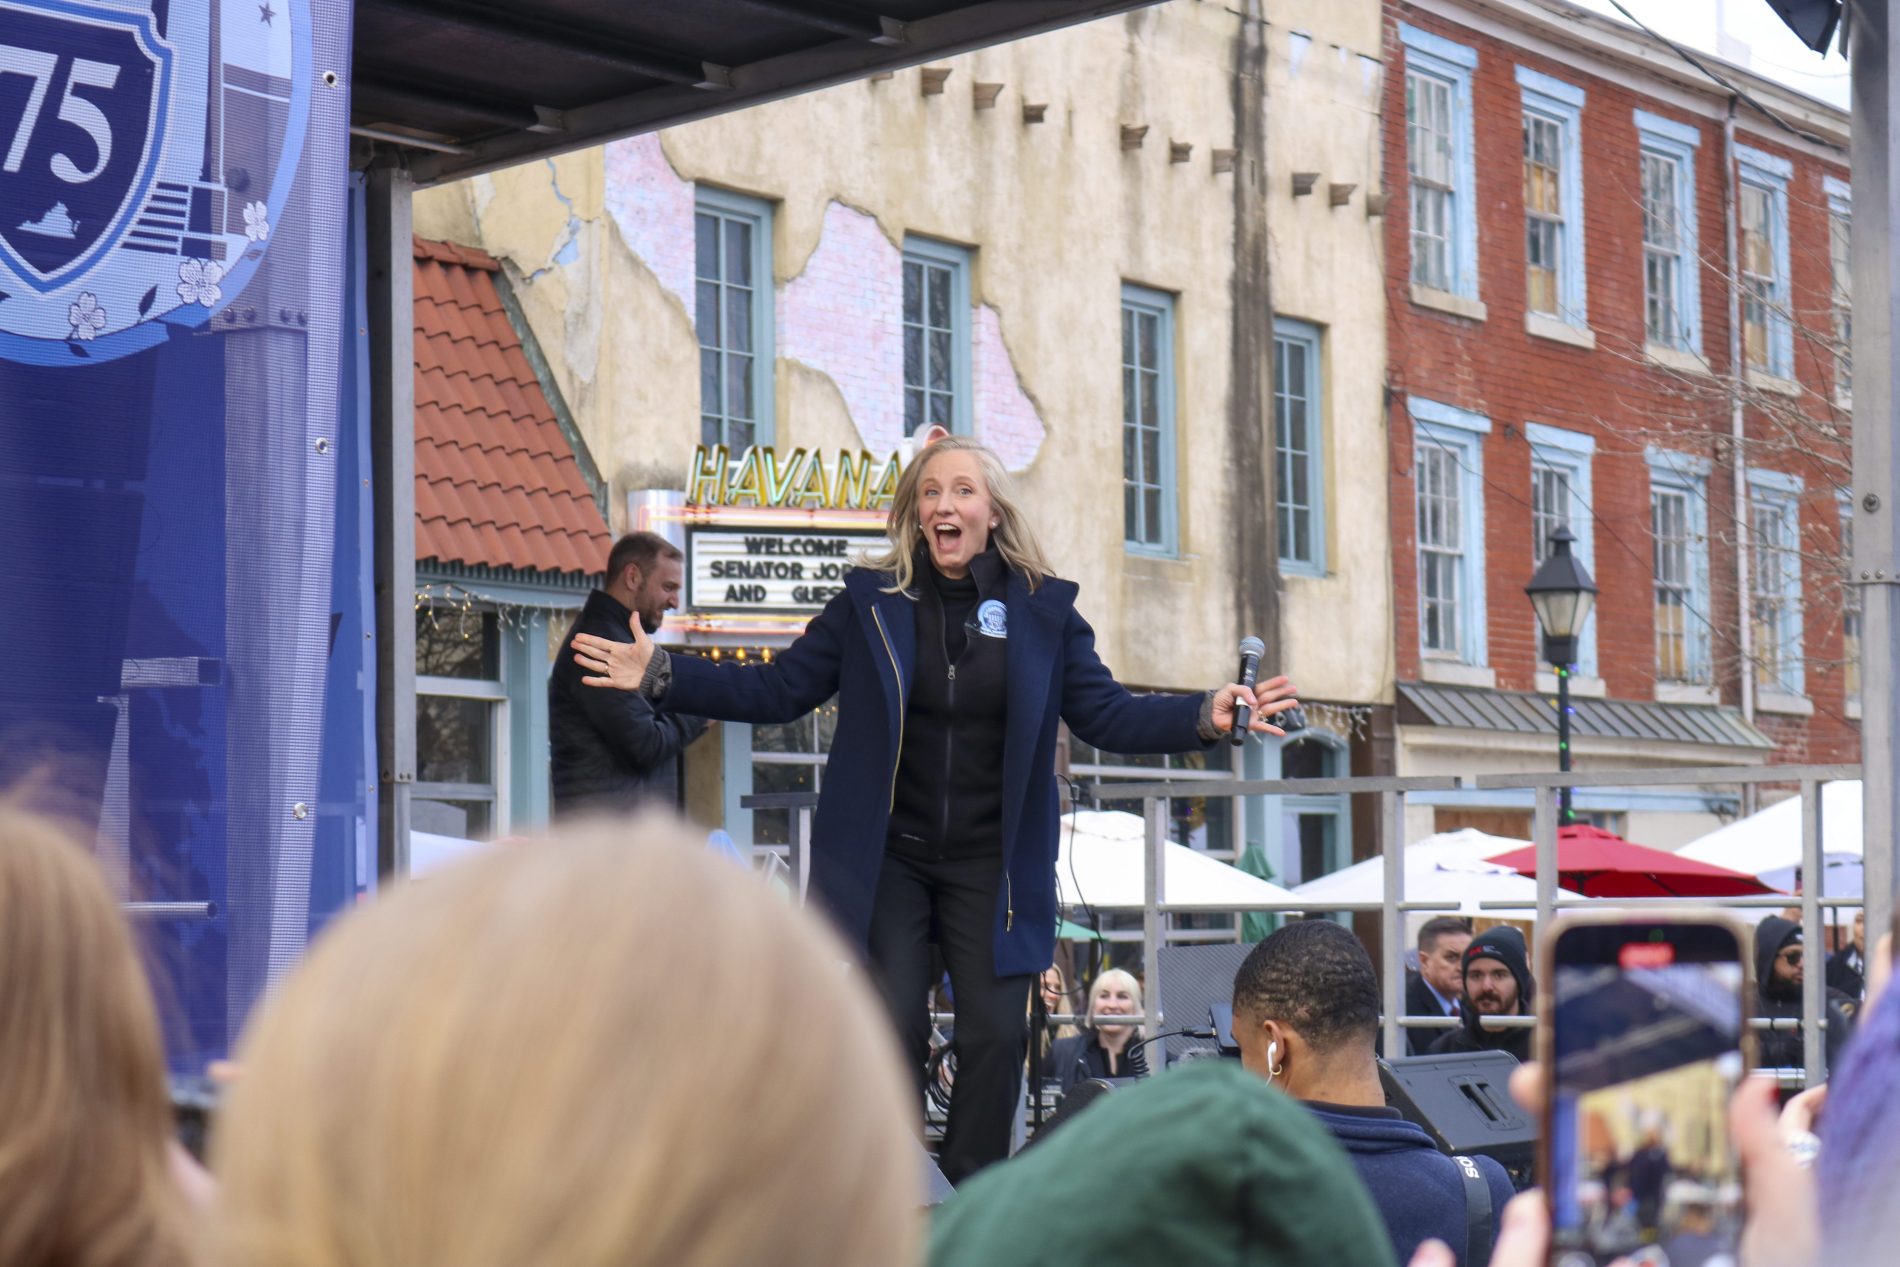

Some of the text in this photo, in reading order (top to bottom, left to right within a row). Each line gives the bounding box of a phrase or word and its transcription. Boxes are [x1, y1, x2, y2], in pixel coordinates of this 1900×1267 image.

[0, 44, 121, 184] 75
[685, 443, 903, 509] HAVANA
[744, 536, 848, 558] WELCOME
[710, 560, 804, 580] SENATOR
[724, 584, 767, 603] AND
